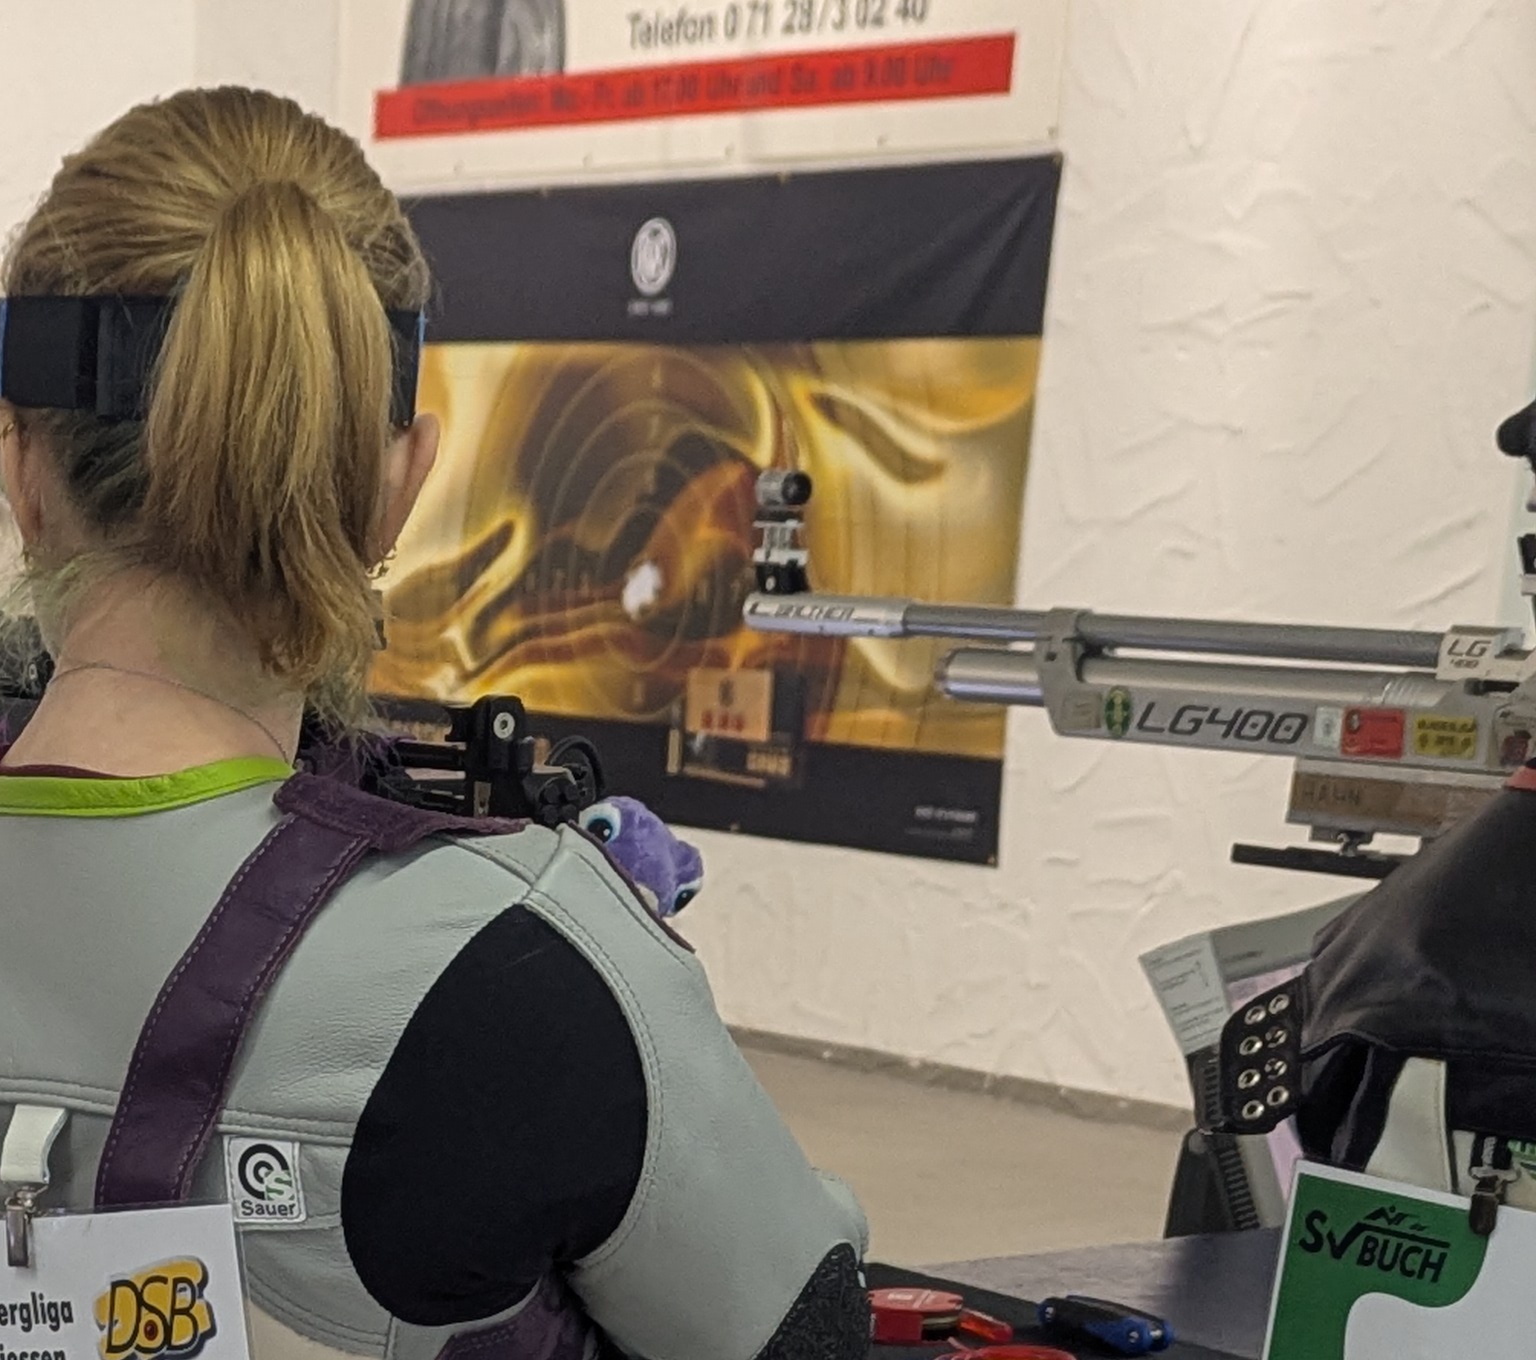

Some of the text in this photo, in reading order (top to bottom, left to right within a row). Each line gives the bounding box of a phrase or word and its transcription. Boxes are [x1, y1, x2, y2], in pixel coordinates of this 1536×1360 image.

[626, 7, 714, 49] Telefon
[724, 2, 742, 41] 0
[1447, 638, 1492, 658] LG
[1136, 701, 1310, 746] LG400
[241, 1199, 296, 1217] Sauer
[1356, 1234, 1449, 1284] BUCH
[105, 1275, 200, 1355] DSB
